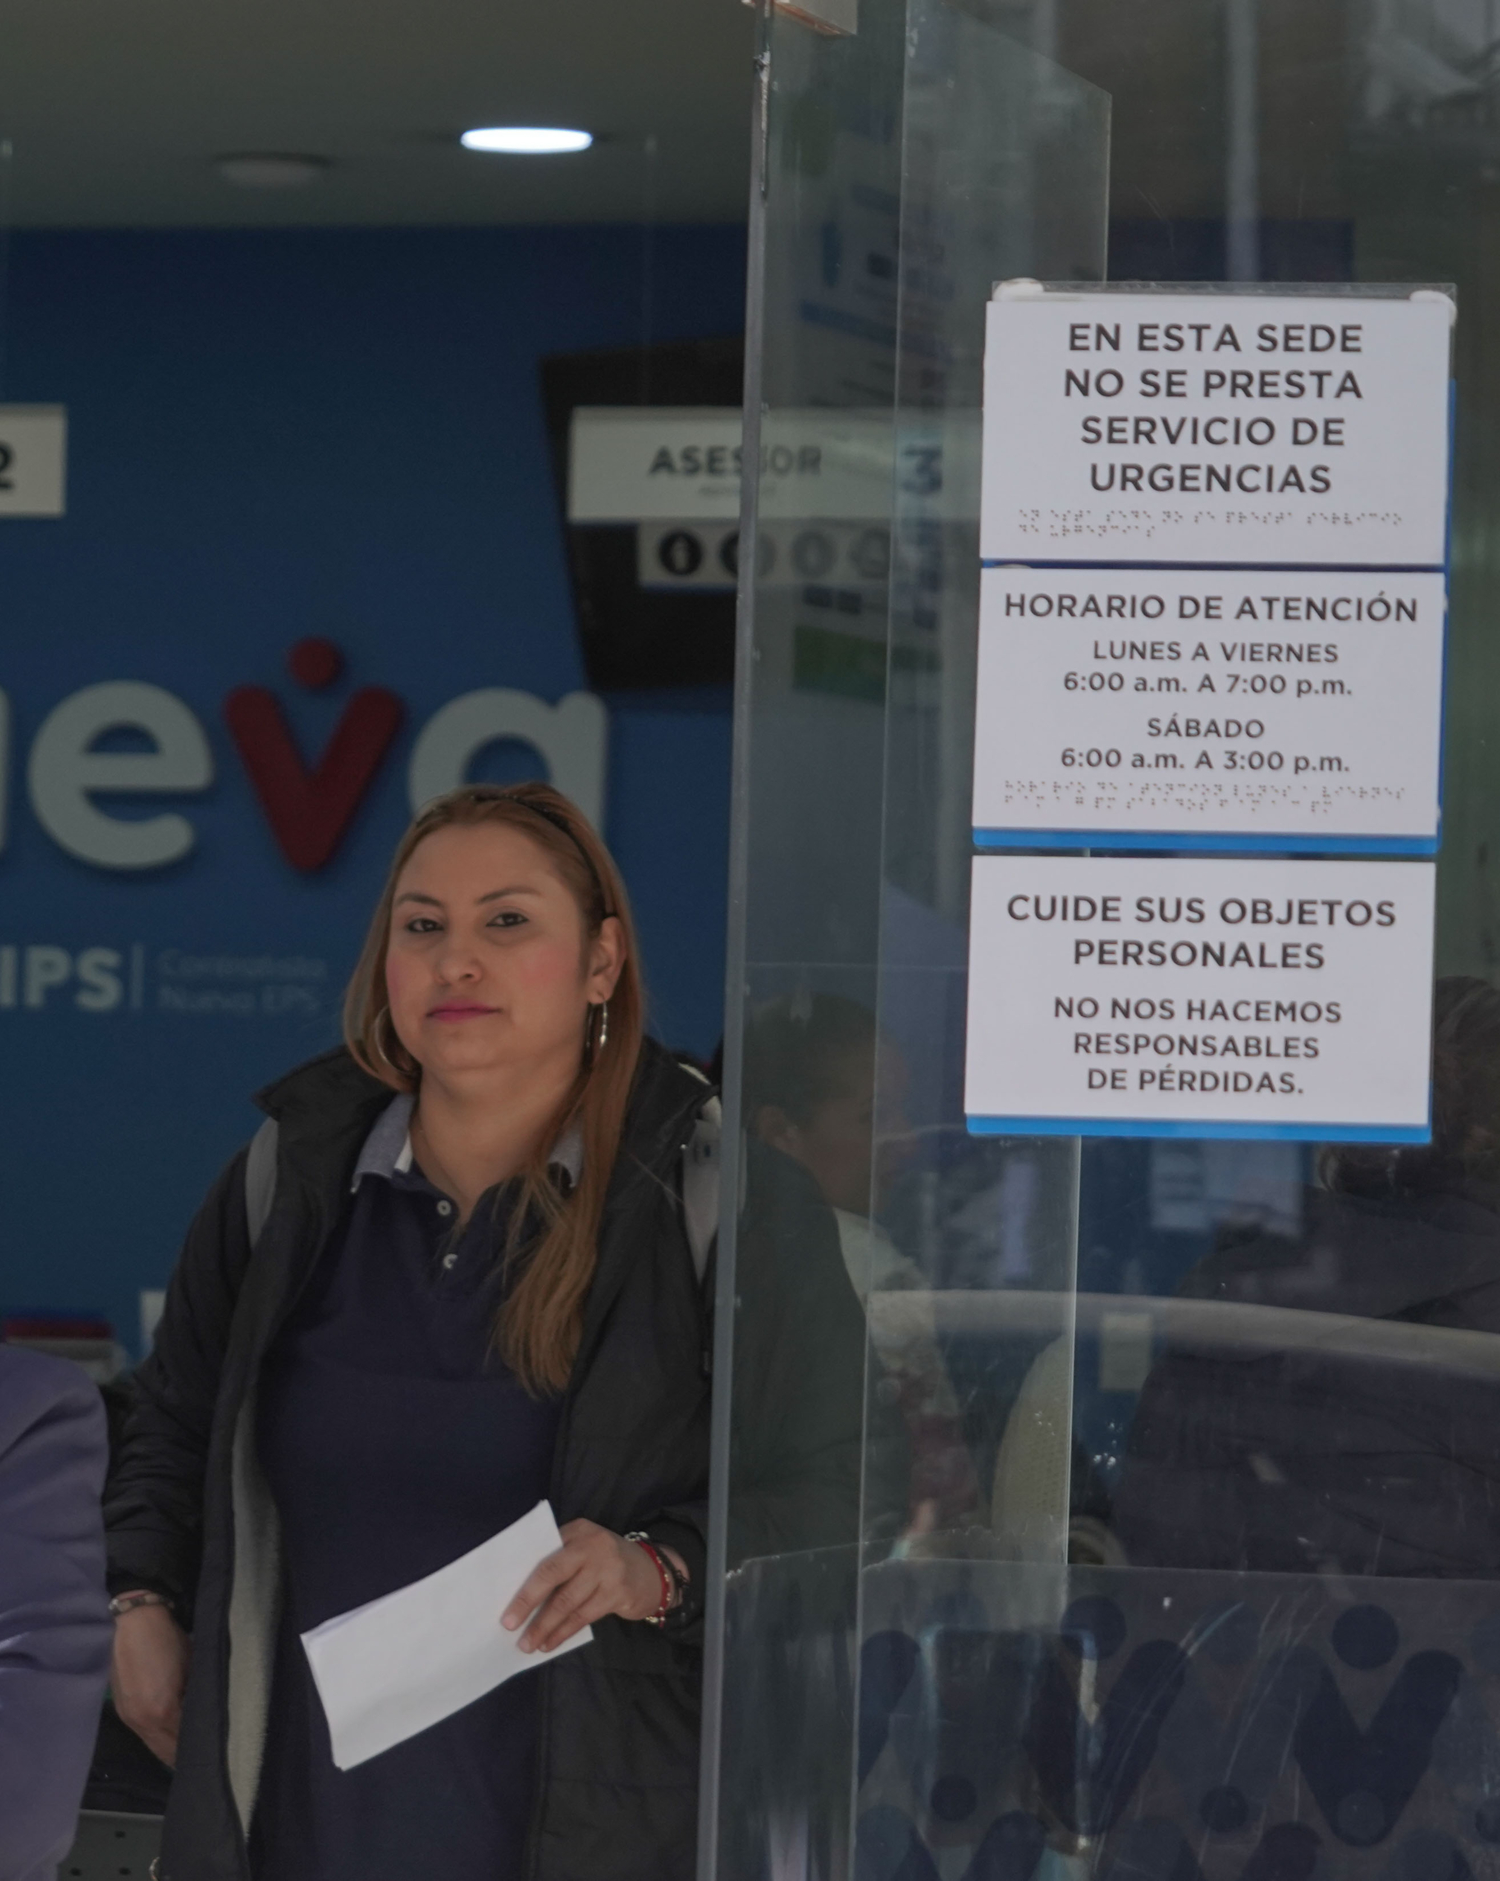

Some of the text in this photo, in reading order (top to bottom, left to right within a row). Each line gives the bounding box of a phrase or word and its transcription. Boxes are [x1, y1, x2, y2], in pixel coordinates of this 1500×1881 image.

[1070, 324, 1362, 352] EN ESTA SEDE
[1065, 369, 1362, 398] NO SE PRESTA
[1082, 416, 1344, 446] SERVICIO DE
[648, 445, 943, 493] ASESOR 3
[1091, 464, 1331, 493] URGENCIAS
[1006, 592, 1416, 621] HORARIO DE ATENCIÓN
[1094, 641, 1338, 663] LUNES A VIERNES
[1064, 672, 1351, 698] 6:00 a.m. A 7:00 p.m.
[1148, 713, 1264, 738] SÁBADO
[1061, 748, 1348, 775] 6:00 a.m. A 3:00 p.m.
[1008, 895, 1395, 926] CUIDE SUS OBJETOS
[1075, 940, 1324, 969] PERSONALES
[1055, 997, 1341, 1023] NO NOS HACEMOS
[1075, 1033, 1319, 1058] RESPONSABLES
[1088, 1064, 1302, 1093] DE PÉRDIDAS.
